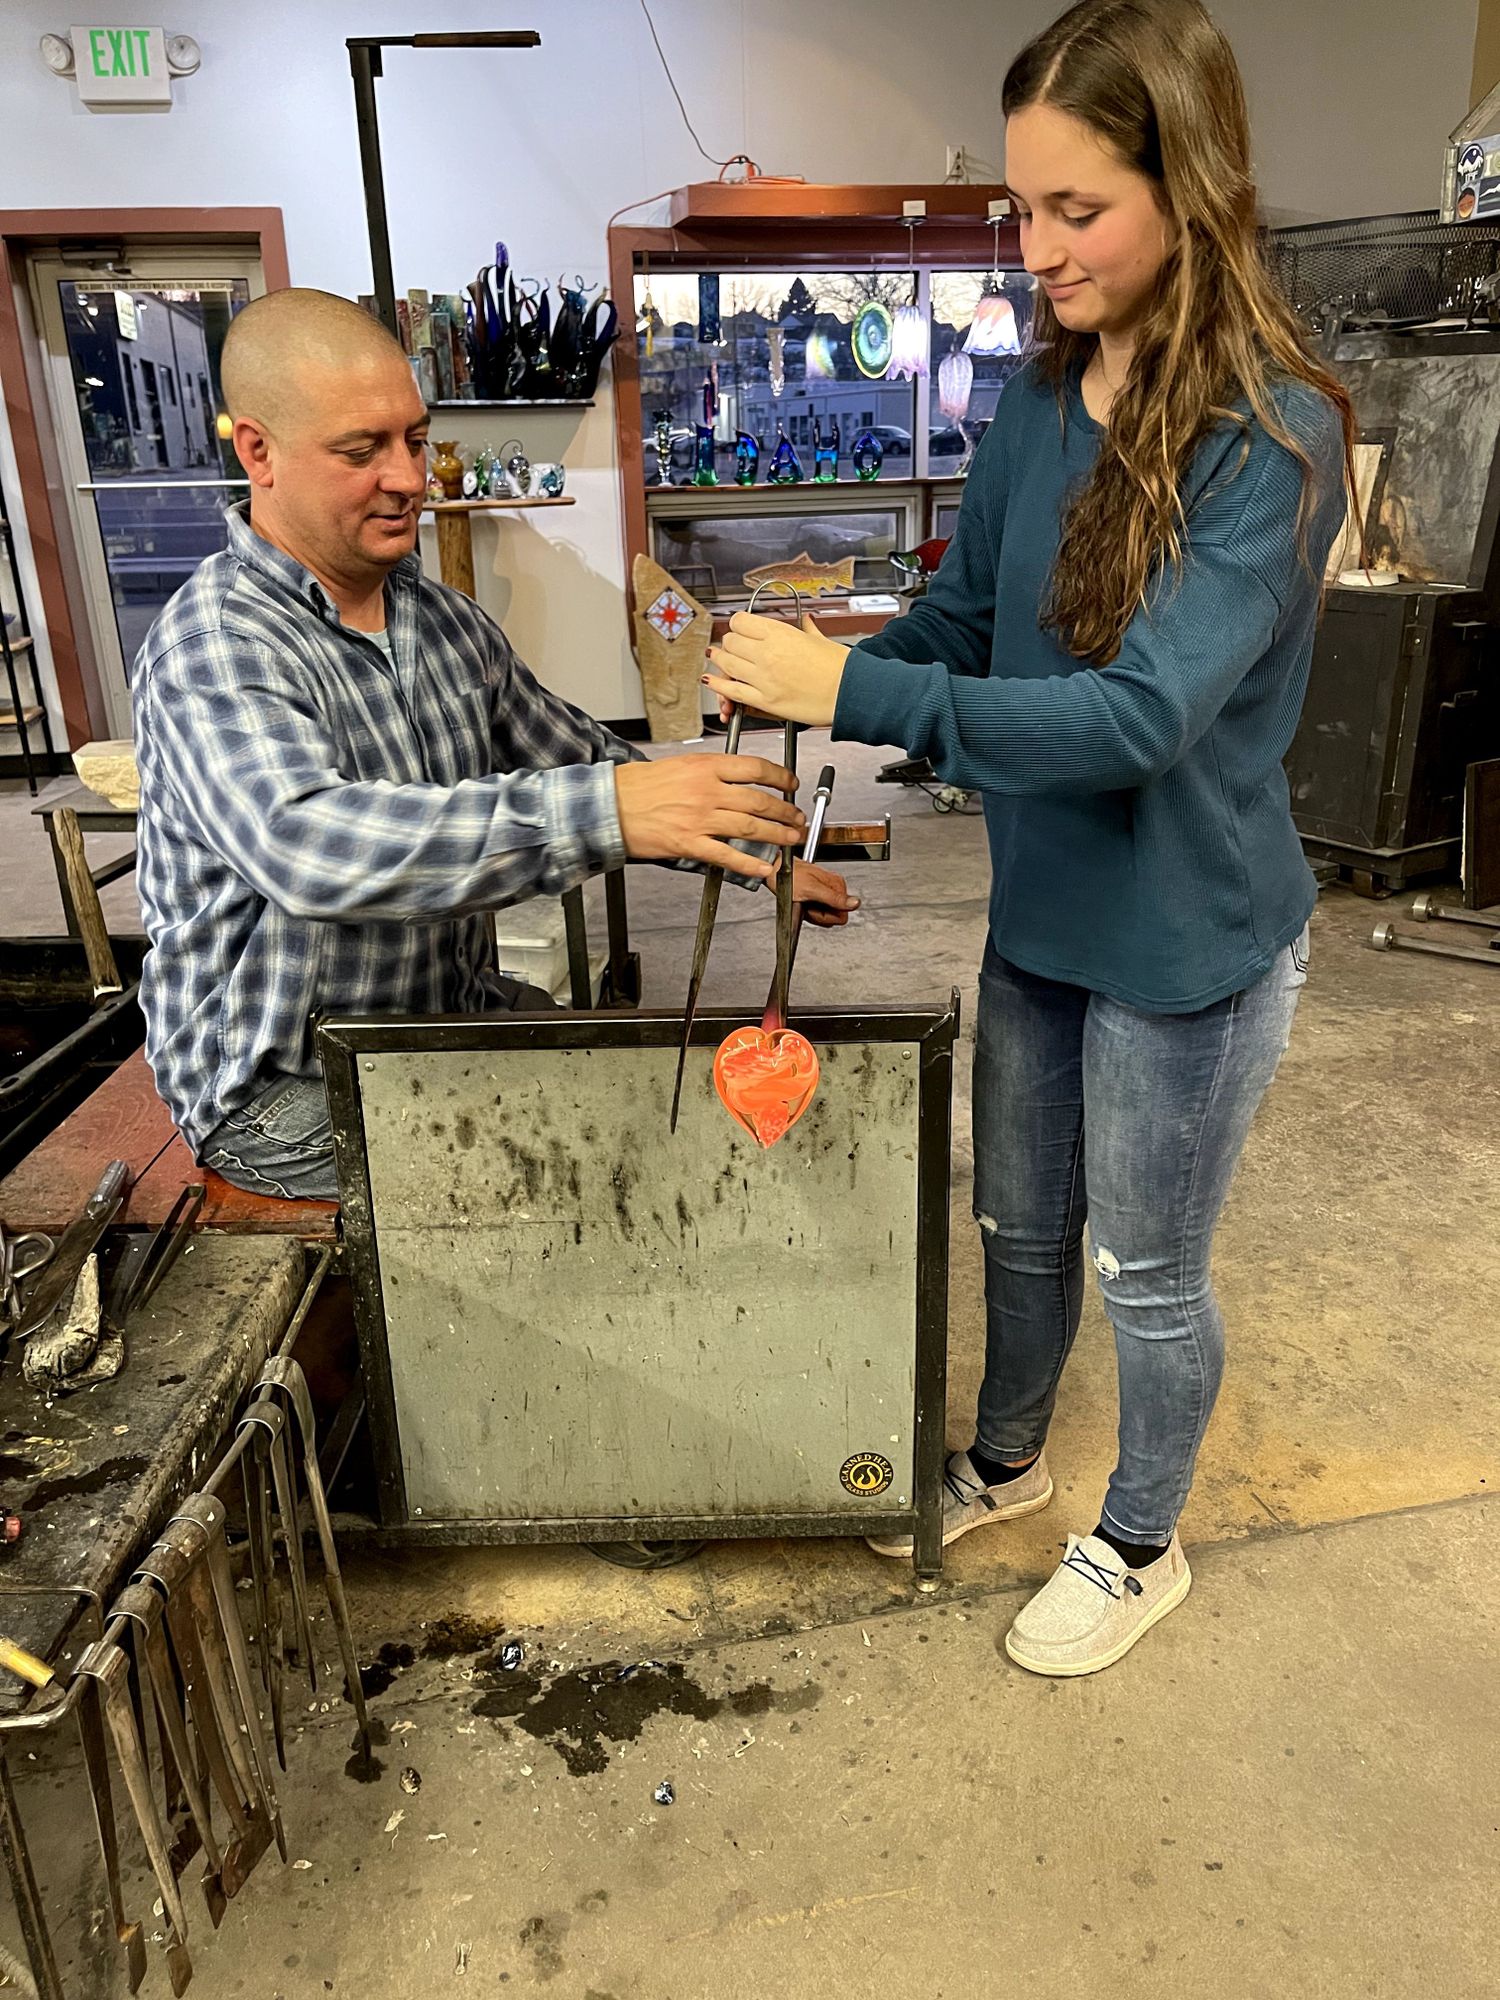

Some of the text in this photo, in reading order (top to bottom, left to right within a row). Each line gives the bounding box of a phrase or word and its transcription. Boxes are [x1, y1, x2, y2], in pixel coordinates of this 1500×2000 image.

[89, 30, 150, 76] EXIT
[841, 1453, 892, 1482] CANNED HEAT
[845, 1483, 864, 1495] GLASS
